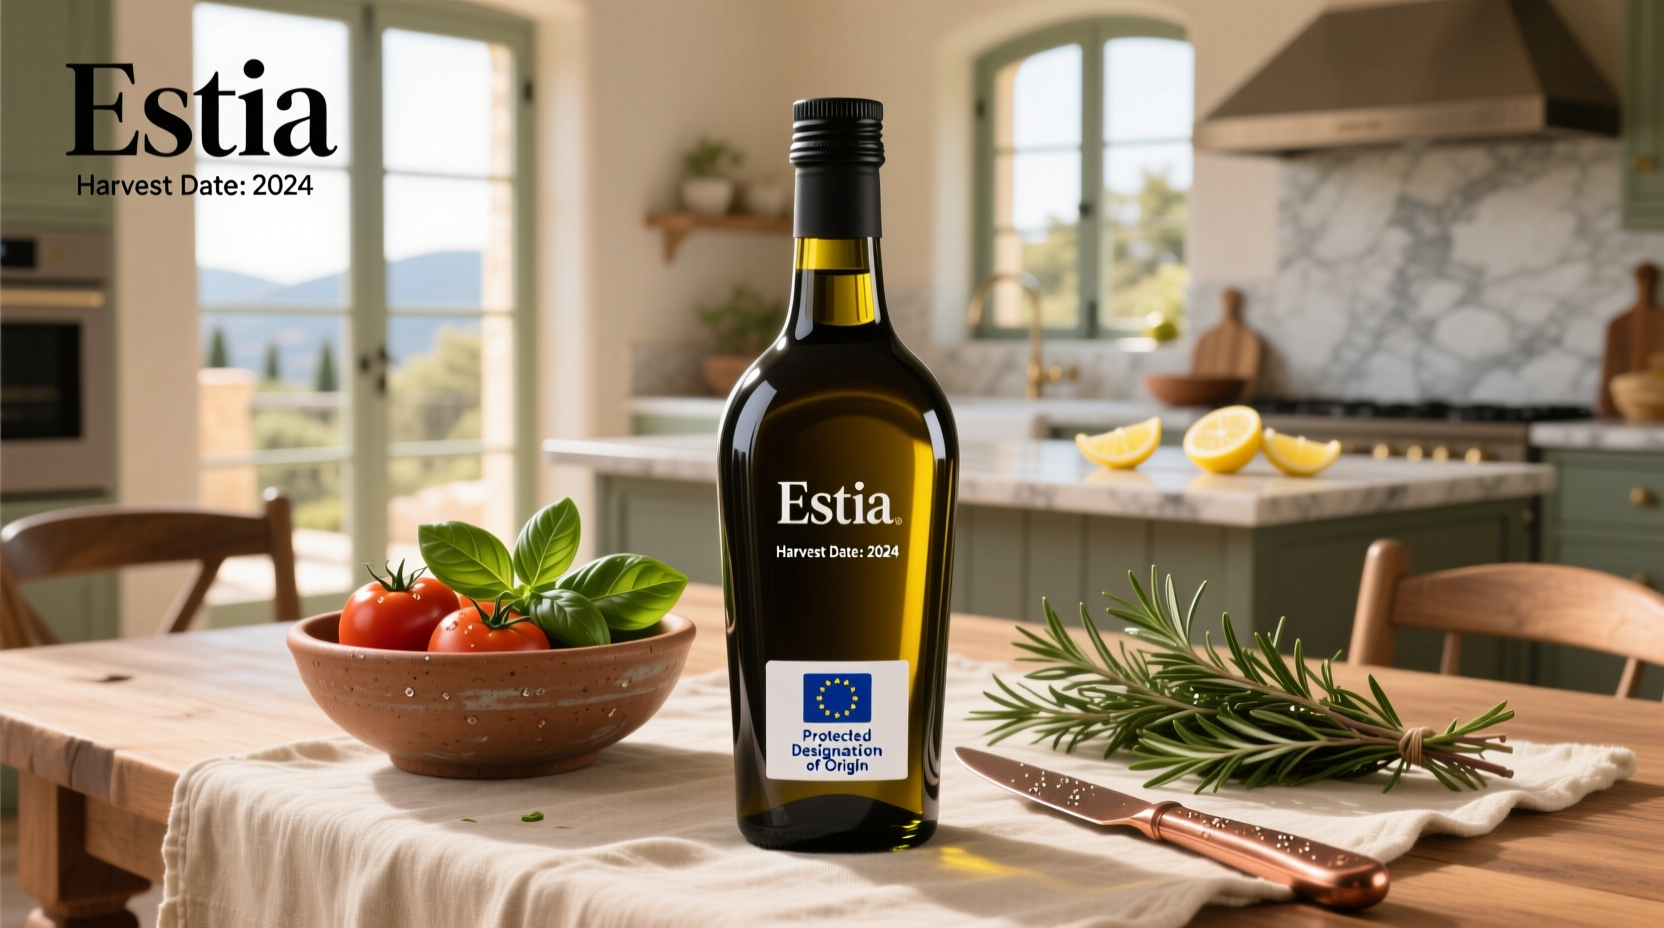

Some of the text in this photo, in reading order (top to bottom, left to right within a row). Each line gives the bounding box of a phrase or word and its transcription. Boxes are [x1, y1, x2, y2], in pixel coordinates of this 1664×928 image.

[777, 481, 895, 525] Estia
[776, 544, 900, 558] Harvest Date: 2024
[802, 728, 872, 742] Protected
[791, 743, 883, 760] Designation
[806, 759, 821, 772] of
